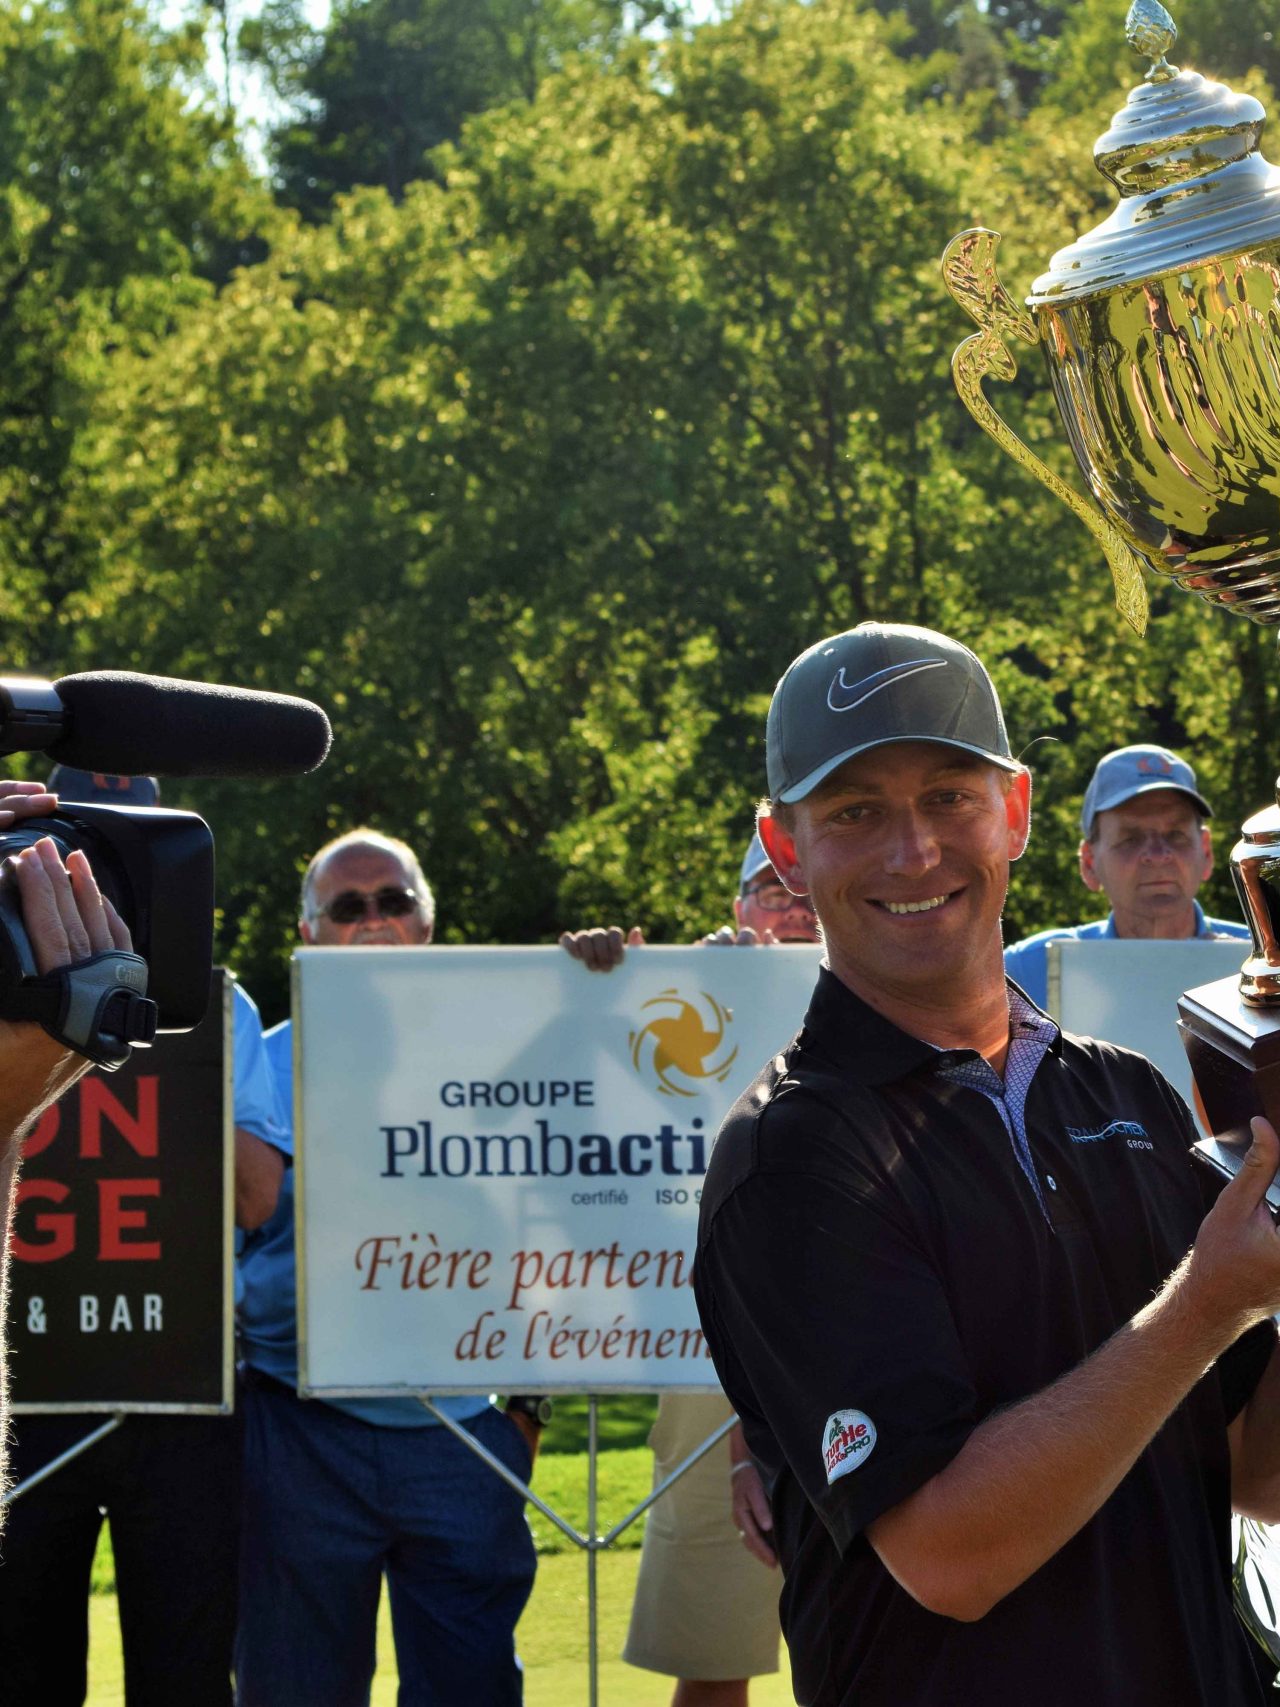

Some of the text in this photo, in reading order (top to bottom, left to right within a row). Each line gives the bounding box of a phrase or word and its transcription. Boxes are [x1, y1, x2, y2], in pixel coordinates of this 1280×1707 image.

[439, 1080, 595, 1107] GROUPE
[570, 1188, 629, 1206] certifié
[655, 1189, 689, 1205] ISO
[355, 1232, 696, 1312] Fière parten
[26, 1293, 163, 1334] & BAR
[453, 1311, 507, 1361] de
